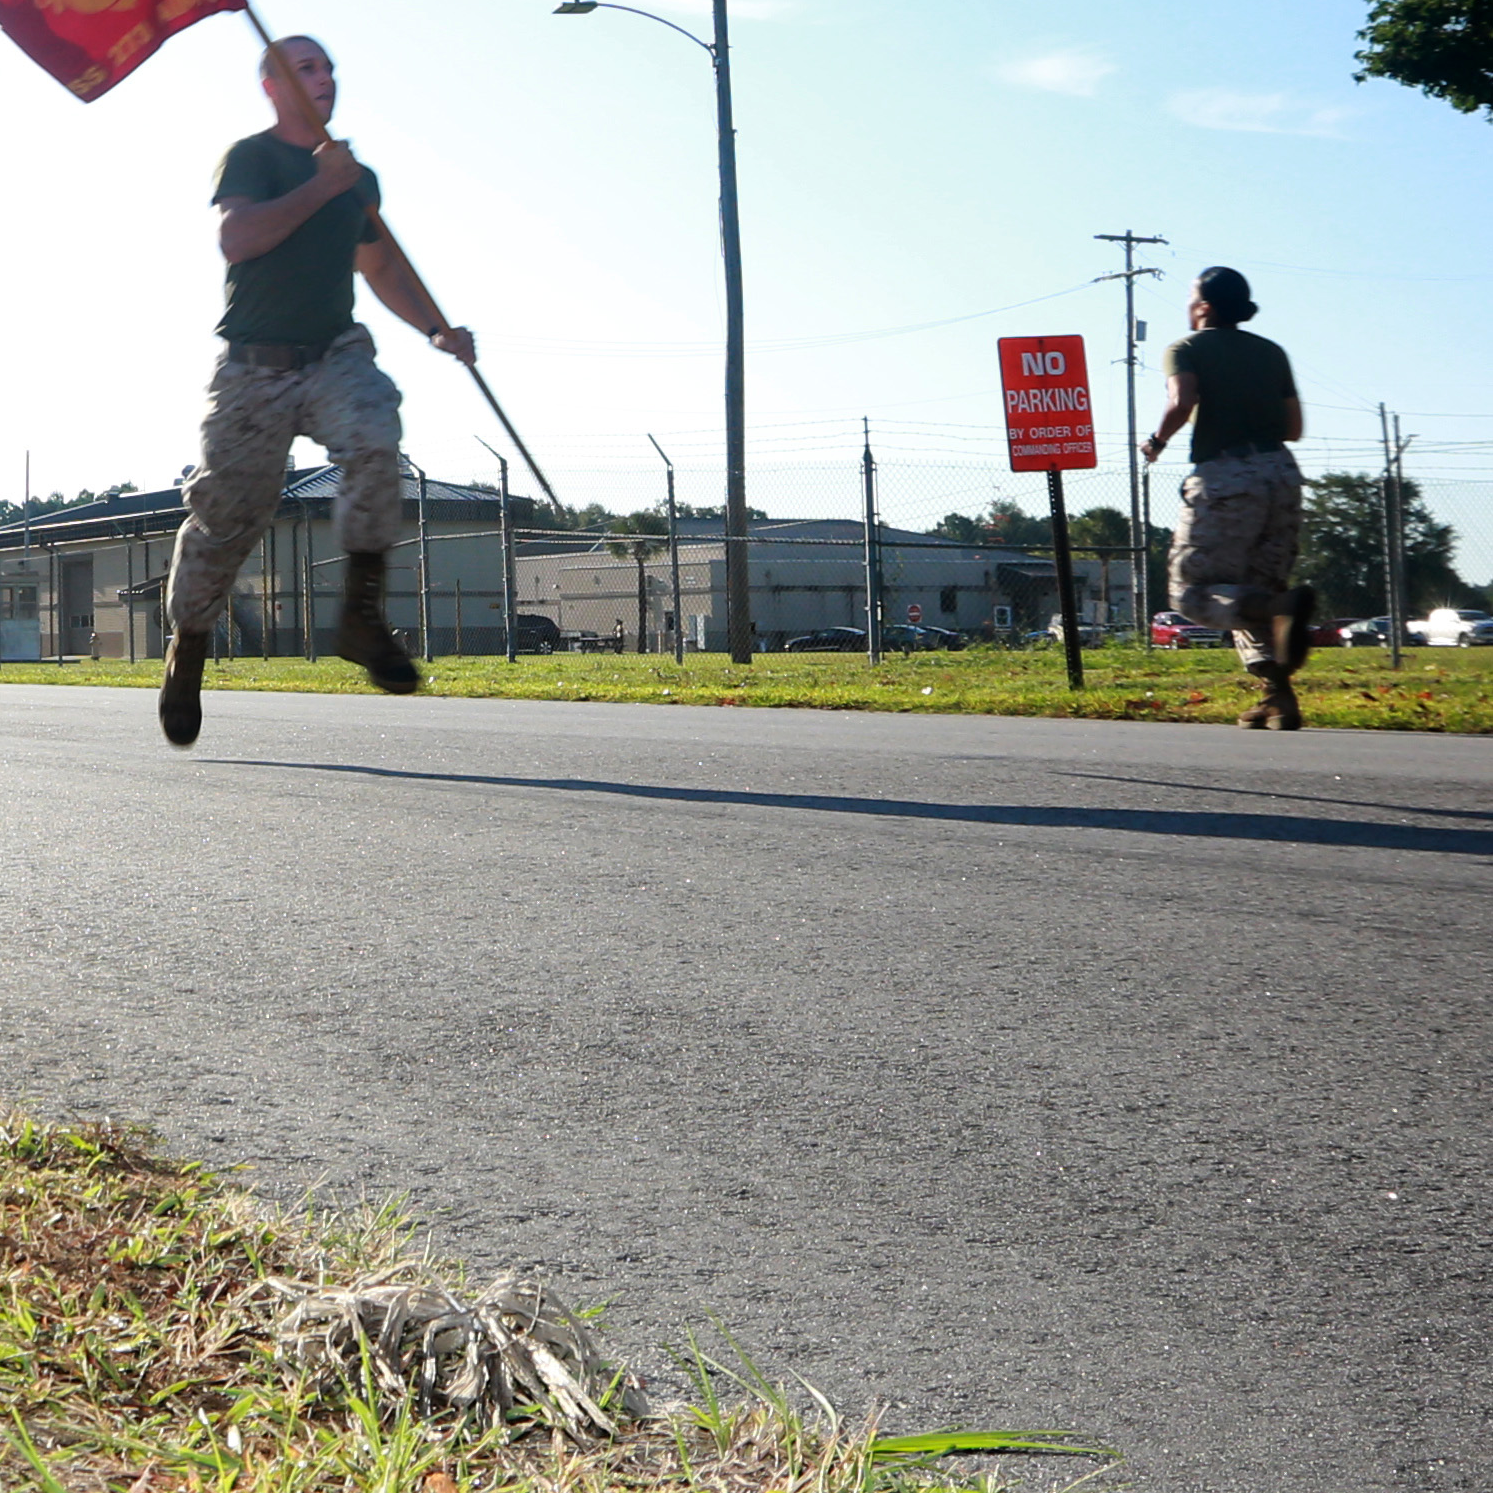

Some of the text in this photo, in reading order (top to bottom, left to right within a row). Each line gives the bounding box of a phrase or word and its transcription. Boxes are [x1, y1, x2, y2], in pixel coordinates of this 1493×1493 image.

[1021, 351, 1066, 376] NO
[1006, 387, 1089, 413] PARKING
[1009, 425, 1092, 440] BY ORDER OF
